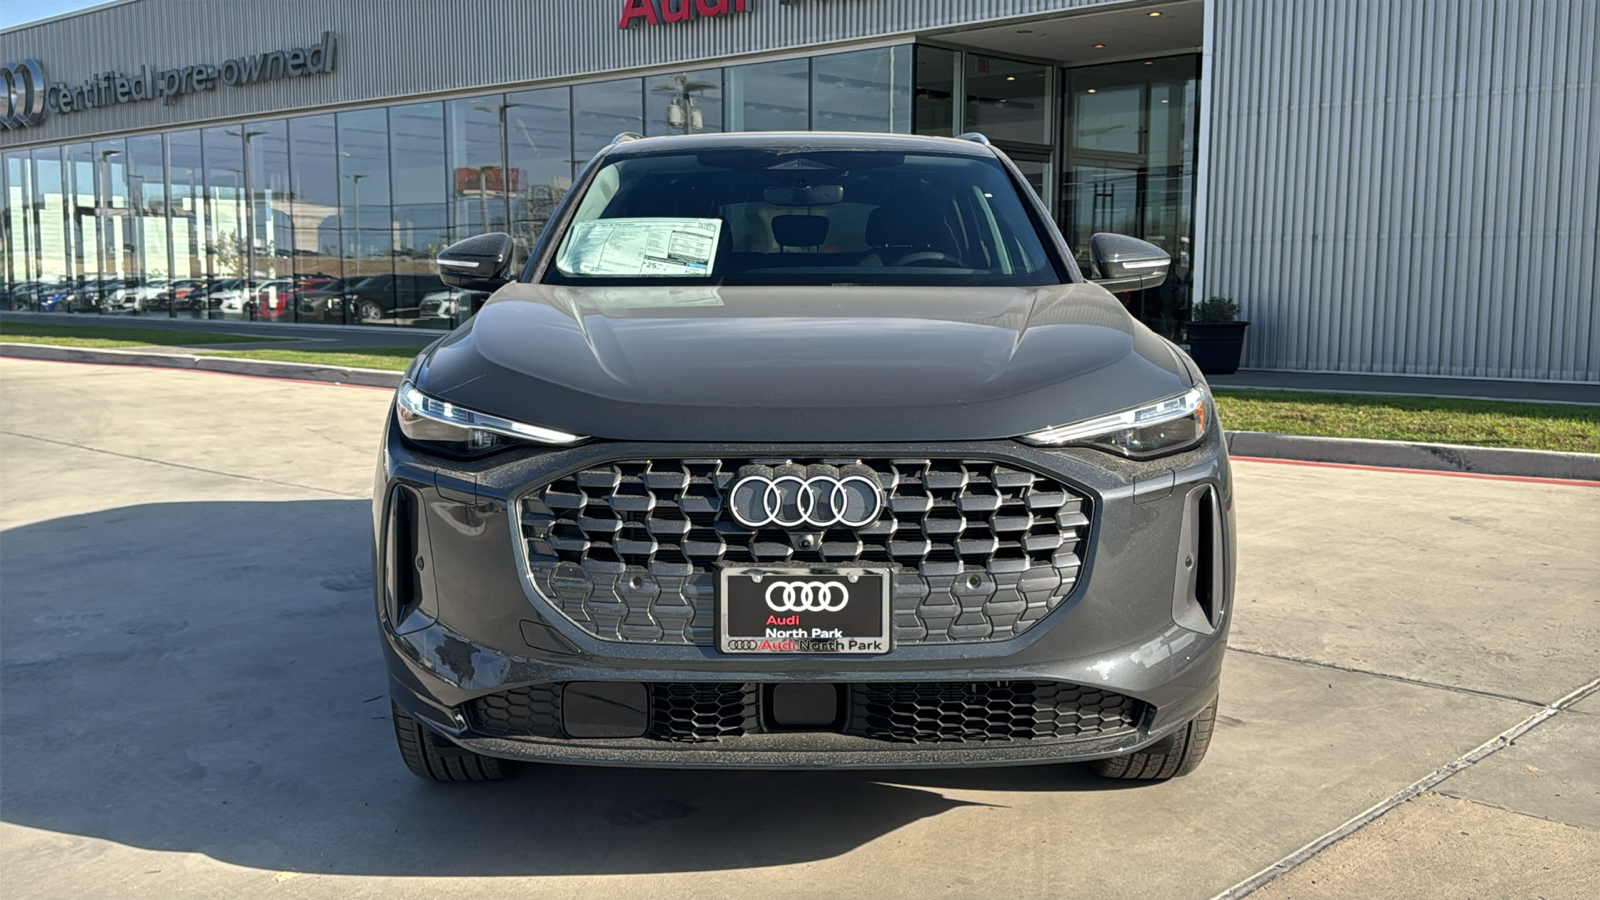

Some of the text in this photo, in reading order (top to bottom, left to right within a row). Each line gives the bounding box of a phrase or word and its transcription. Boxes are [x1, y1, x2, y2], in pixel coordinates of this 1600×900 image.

[46, 65, 149, 114] Certified
[766, 615, 800, 625] Audi
[765, 628, 843, 638] North Park
[759, 639, 882, 650] Audi North Park
